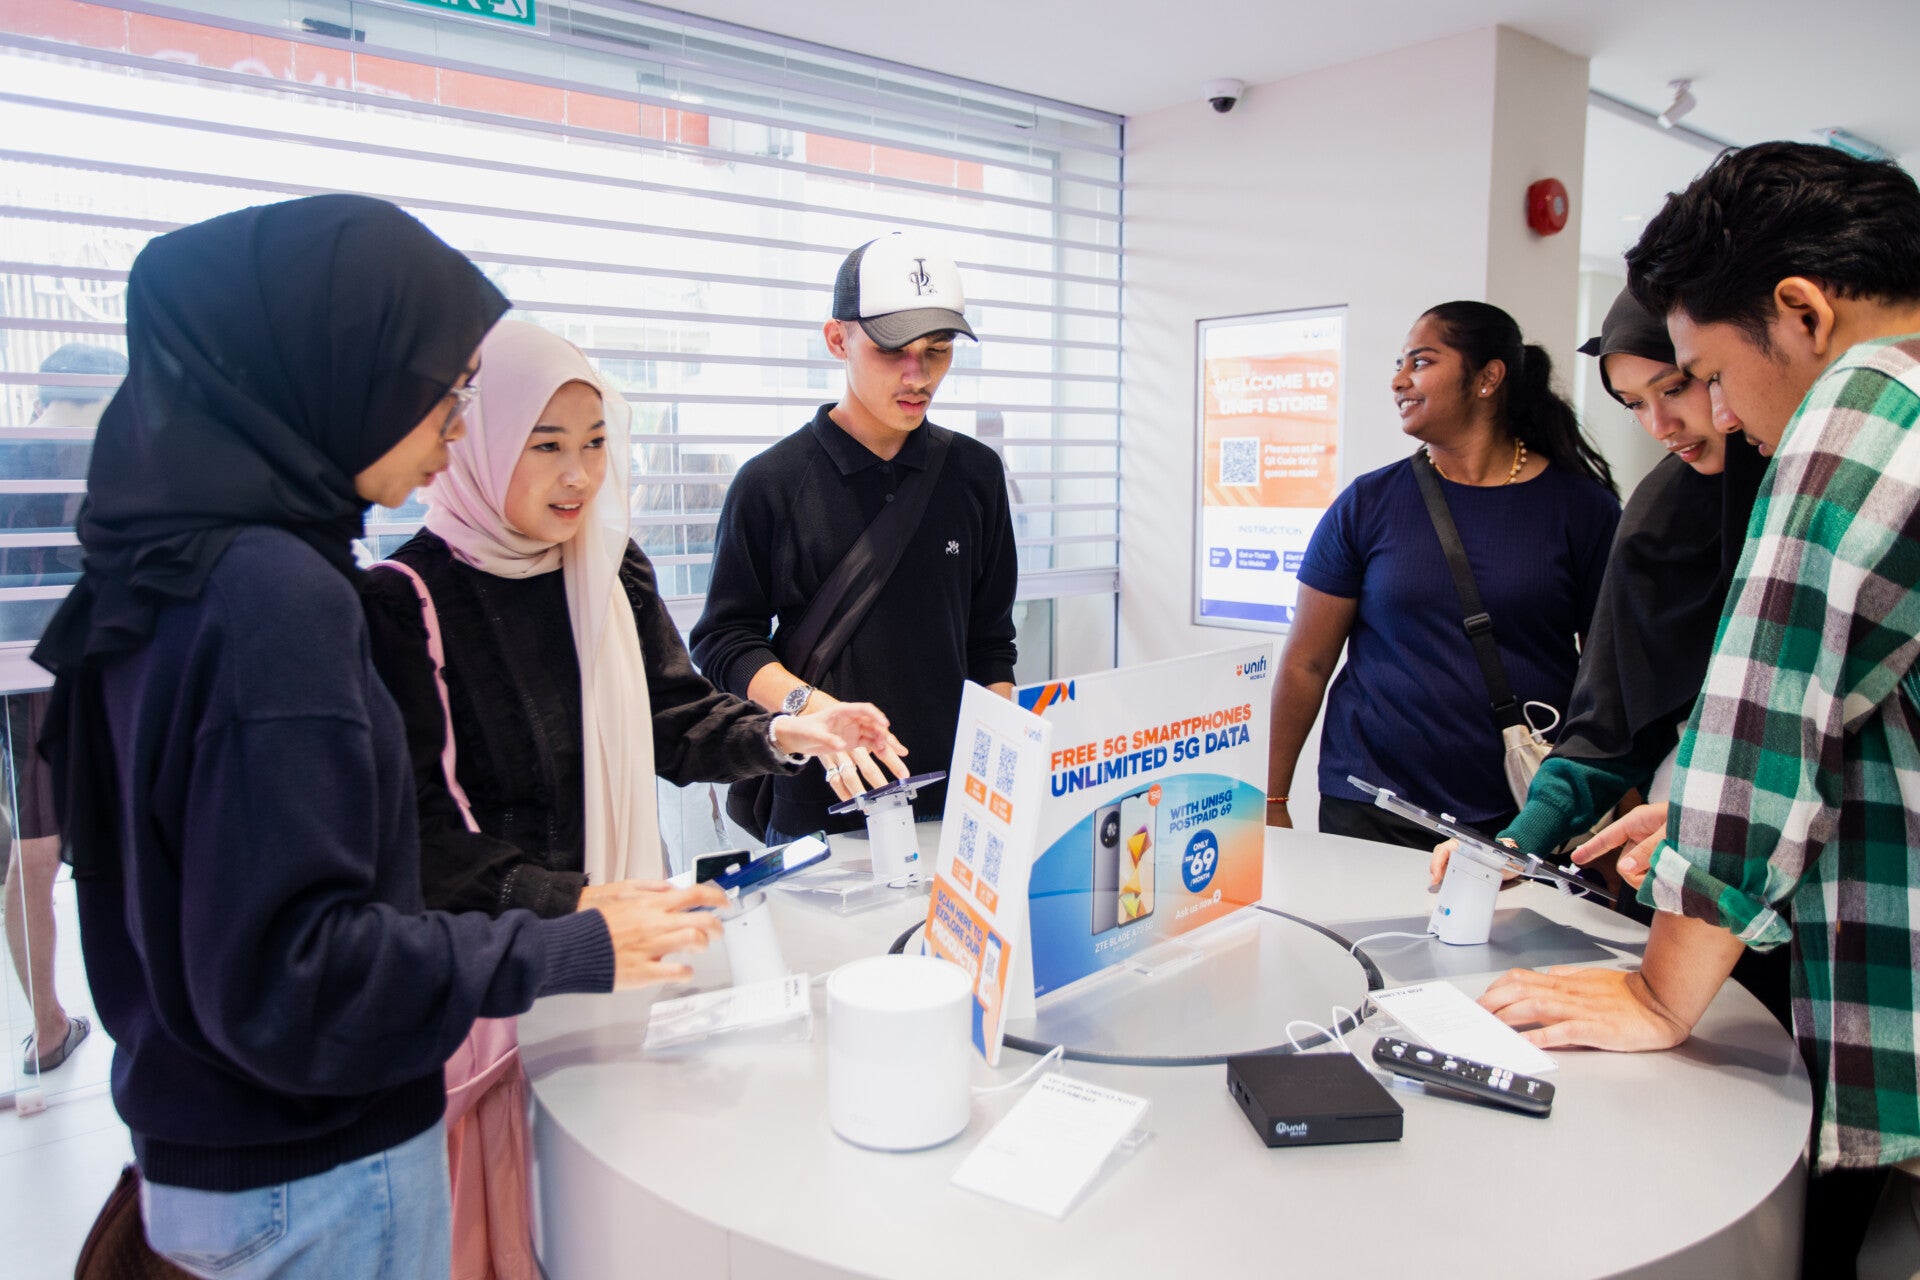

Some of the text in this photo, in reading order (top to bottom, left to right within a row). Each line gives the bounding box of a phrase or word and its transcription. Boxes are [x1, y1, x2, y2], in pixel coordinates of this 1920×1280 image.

[1215, 370, 1334, 393] WELCOME TO
[1220, 394, 1328, 415] UNIFI STORE
[1239, 525, 1302, 535] INSTRUCTION
[1244, 655, 1267, 676] unifi
[1050, 703, 1252, 772] FREE 5G SMARTPHONES
[1051, 723, 1250, 797] UNLIMITED 5G DATA
[1170, 789, 1233, 820] WITH UNI5G
[1169, 803, 1232, 834] POSTPAID 69
[1192, 838, 1209, 852] ONLY
[1190, 847, 1215, 876] 69
[937, 889, 955, 915] SCAN
[955, 905, 973, 932] HERE
[973, 921, 983, 943] TO
[1175, 906, 1189, 920] Ask
[935, 903, 981, 958] EXPLORE OUR
[1095, 939, 1109, 953] ZTE
[1109, 930, 1131, 947] BLADE
[1287, 1121, 1308, 1132] unifi
